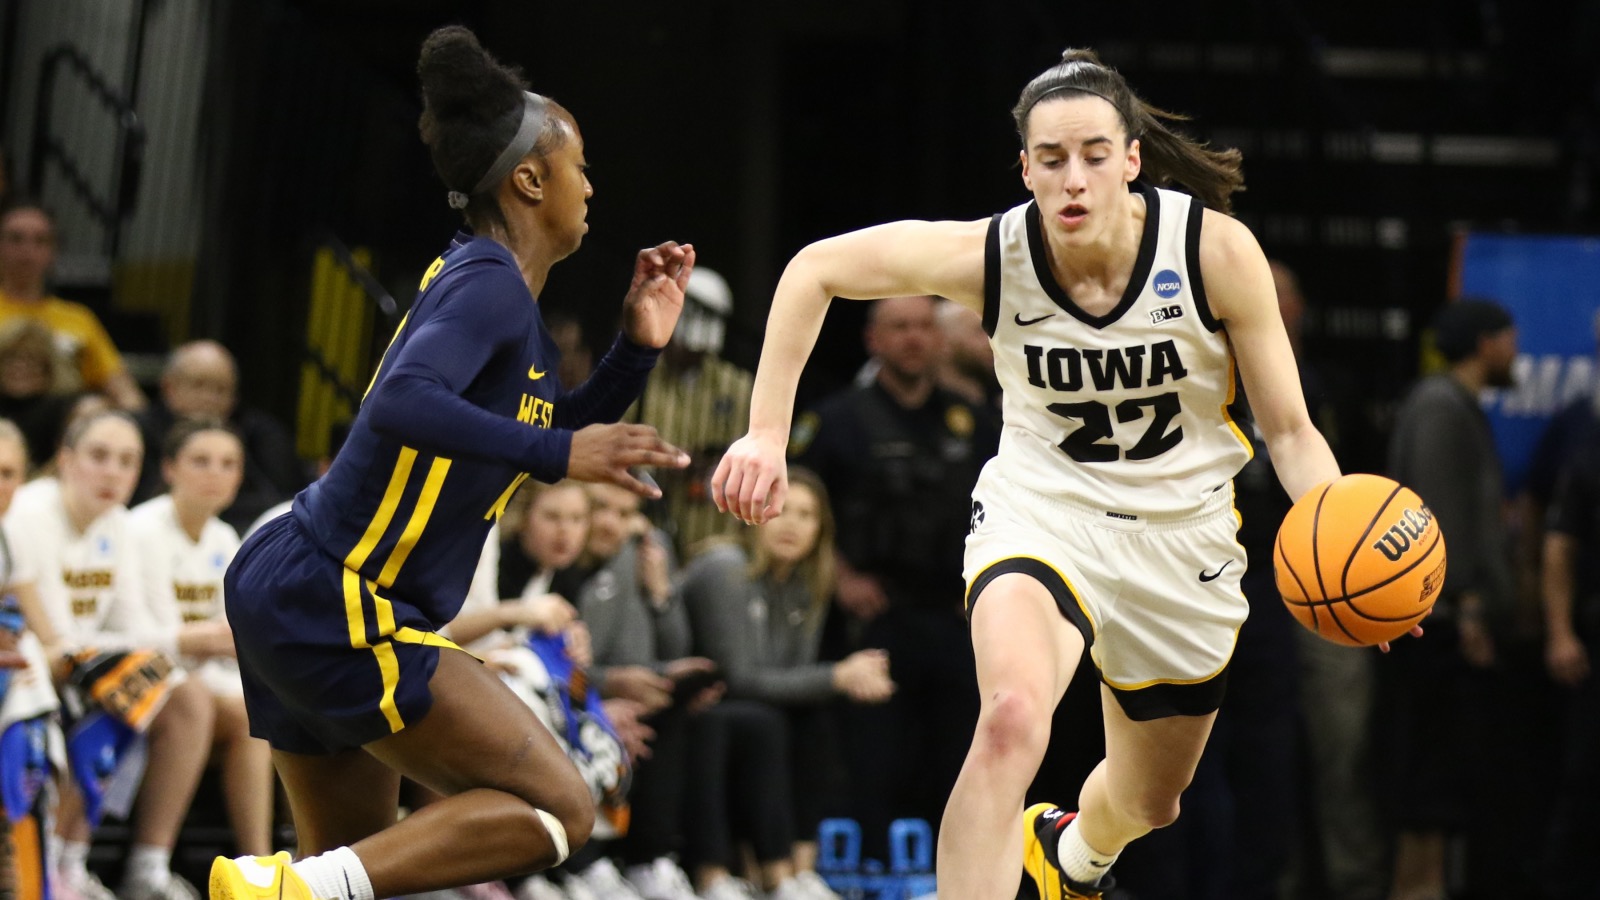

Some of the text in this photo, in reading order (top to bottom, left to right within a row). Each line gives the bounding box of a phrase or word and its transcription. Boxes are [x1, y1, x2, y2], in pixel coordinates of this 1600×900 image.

[1157, 282, 1180, 291] NCAA
[1024, 339, 1188, 391] IOWA
[1046, 392, 1184, 462] 22
[1373, 504, 1432, 562] Wilso
